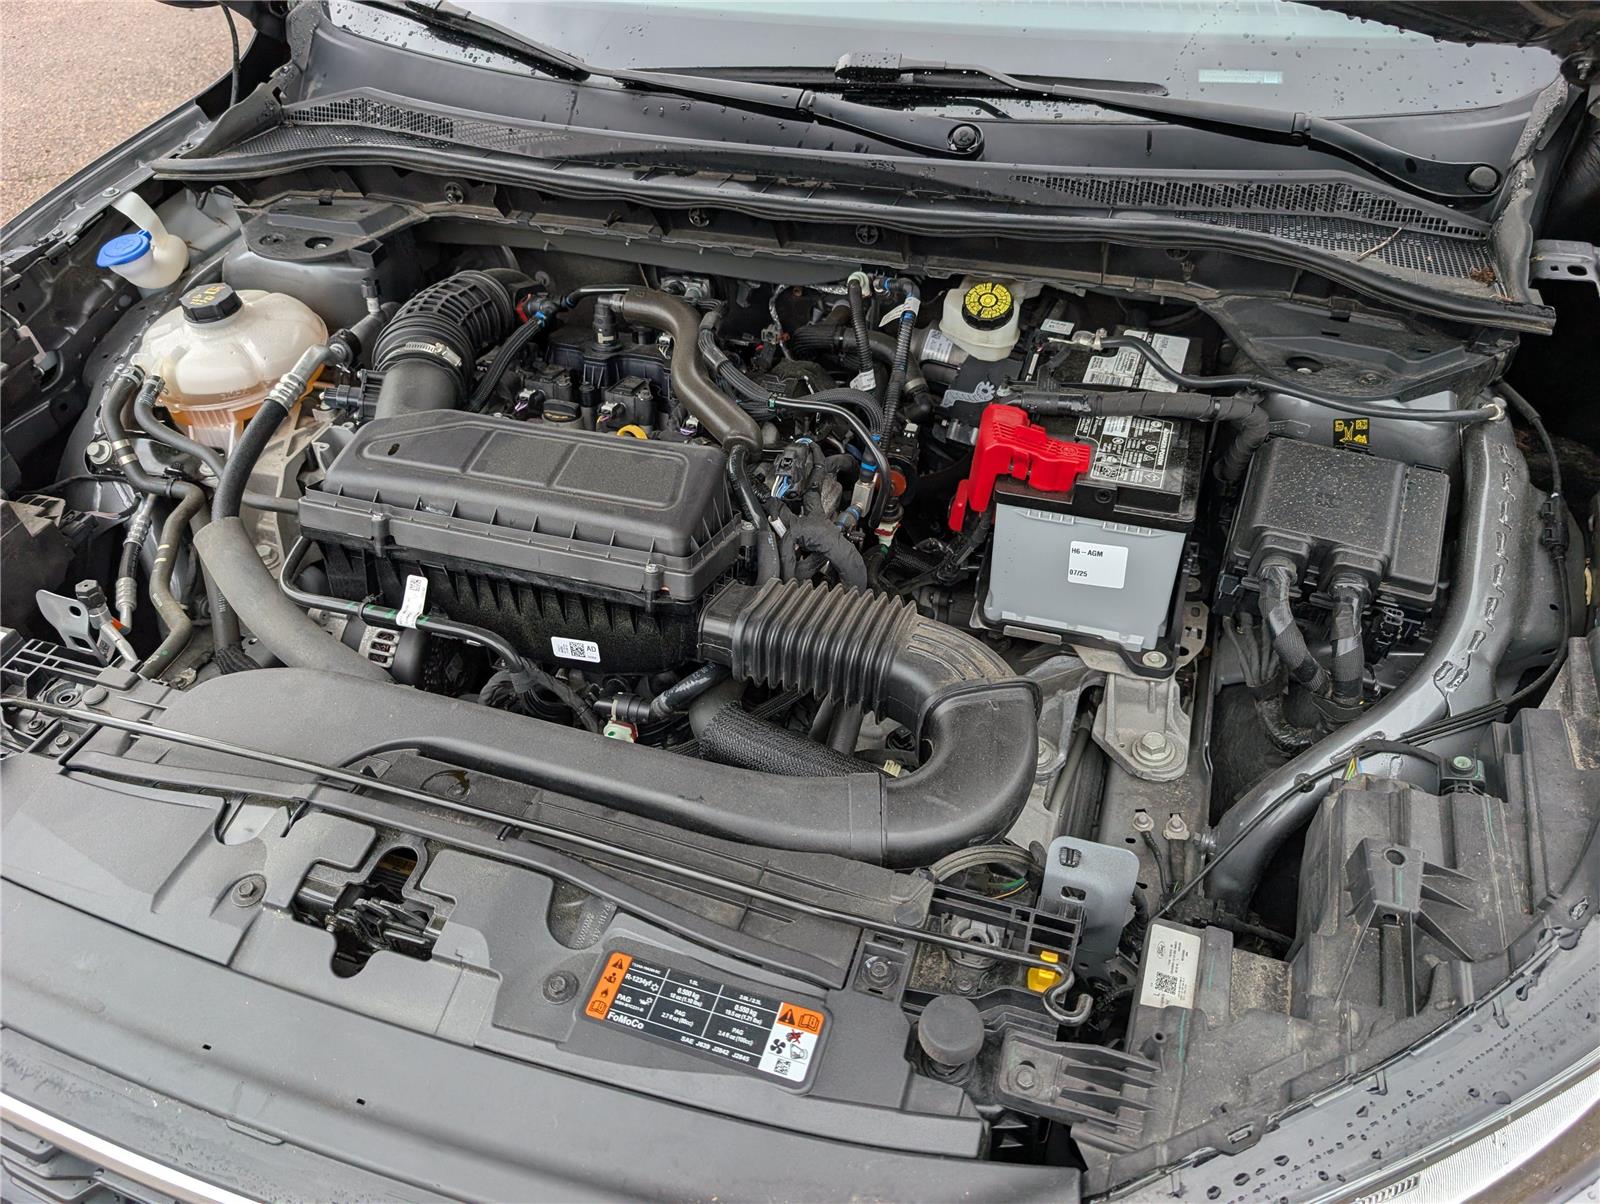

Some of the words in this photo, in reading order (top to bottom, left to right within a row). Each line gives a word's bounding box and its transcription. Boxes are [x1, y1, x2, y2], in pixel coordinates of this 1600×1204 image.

[1069, 569, 1088, 577] 07/25
[625, 973, 652, 987] R-1234yf
[616, 993, 632, 1003] PAG
[674, 1009, 686, 1017] PAG
[607, 1012, 644, 1029] FoMoCo
[731, 1027, 744, 1036] PAG
[681, 1036, 694, 1044] SAE
